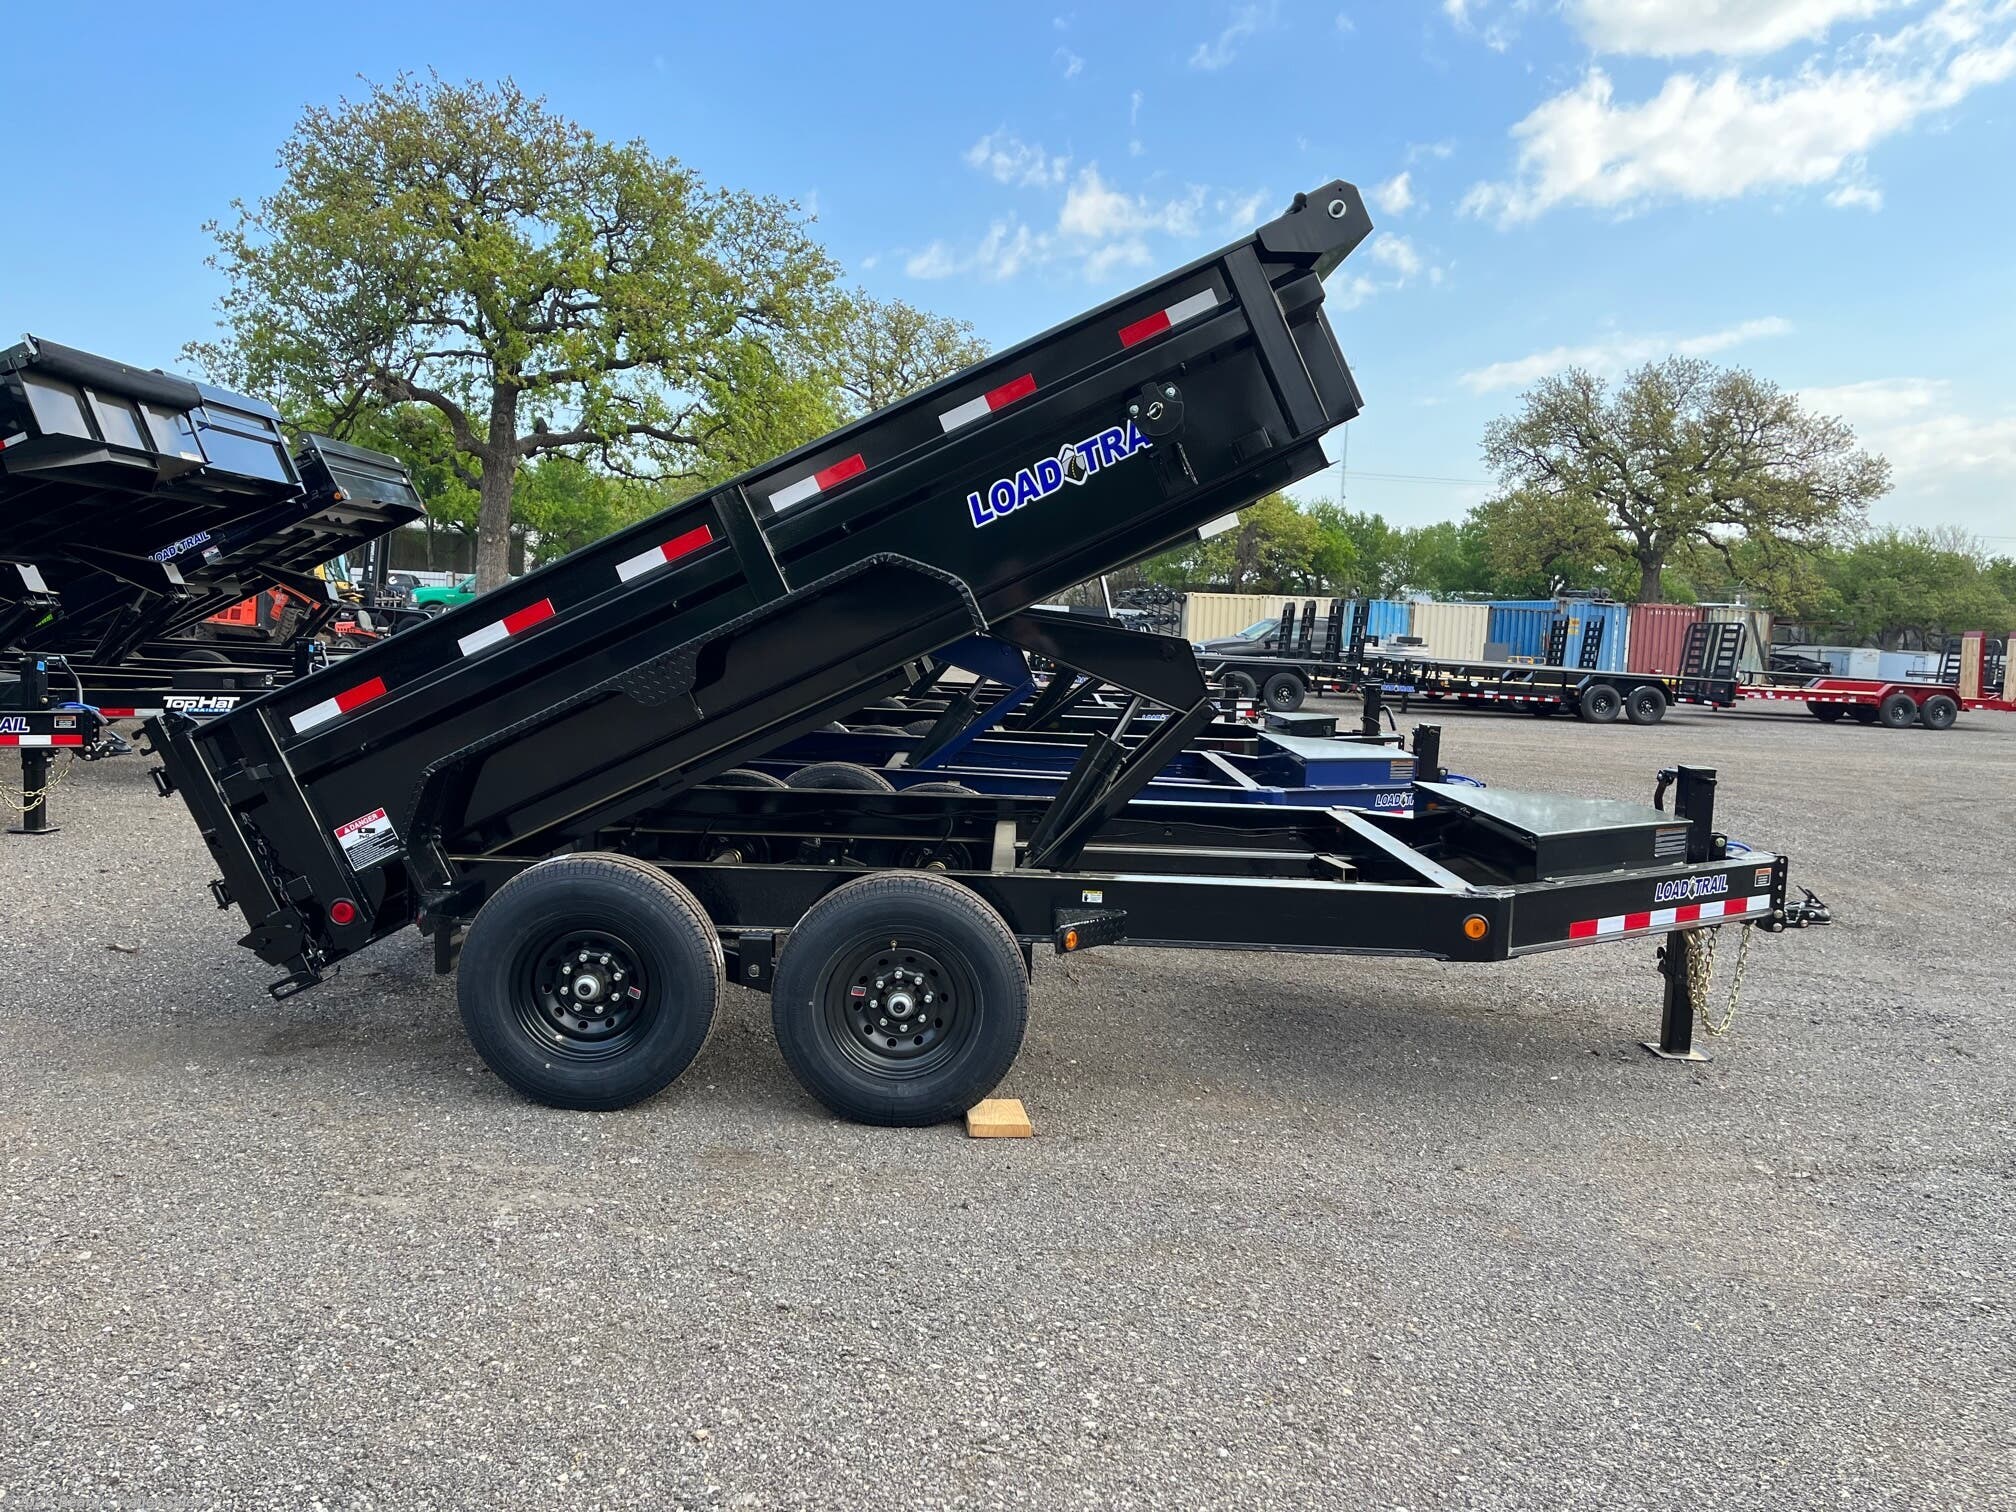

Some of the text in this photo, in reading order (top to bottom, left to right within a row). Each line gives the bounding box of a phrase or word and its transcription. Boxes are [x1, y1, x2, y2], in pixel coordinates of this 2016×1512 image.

[967, 418, 1153, 529] LOAD TRA
[180, 531, 211, 551] TRAIL
[0, 716, 31, 733] AIL
[1374, 793, 1401, 808] LOAD
[348, 812, 379, 831] DANGER
[1654, 879, 1690, 902] LOAD
[1693, 874, 1729, 899] TRAIL
